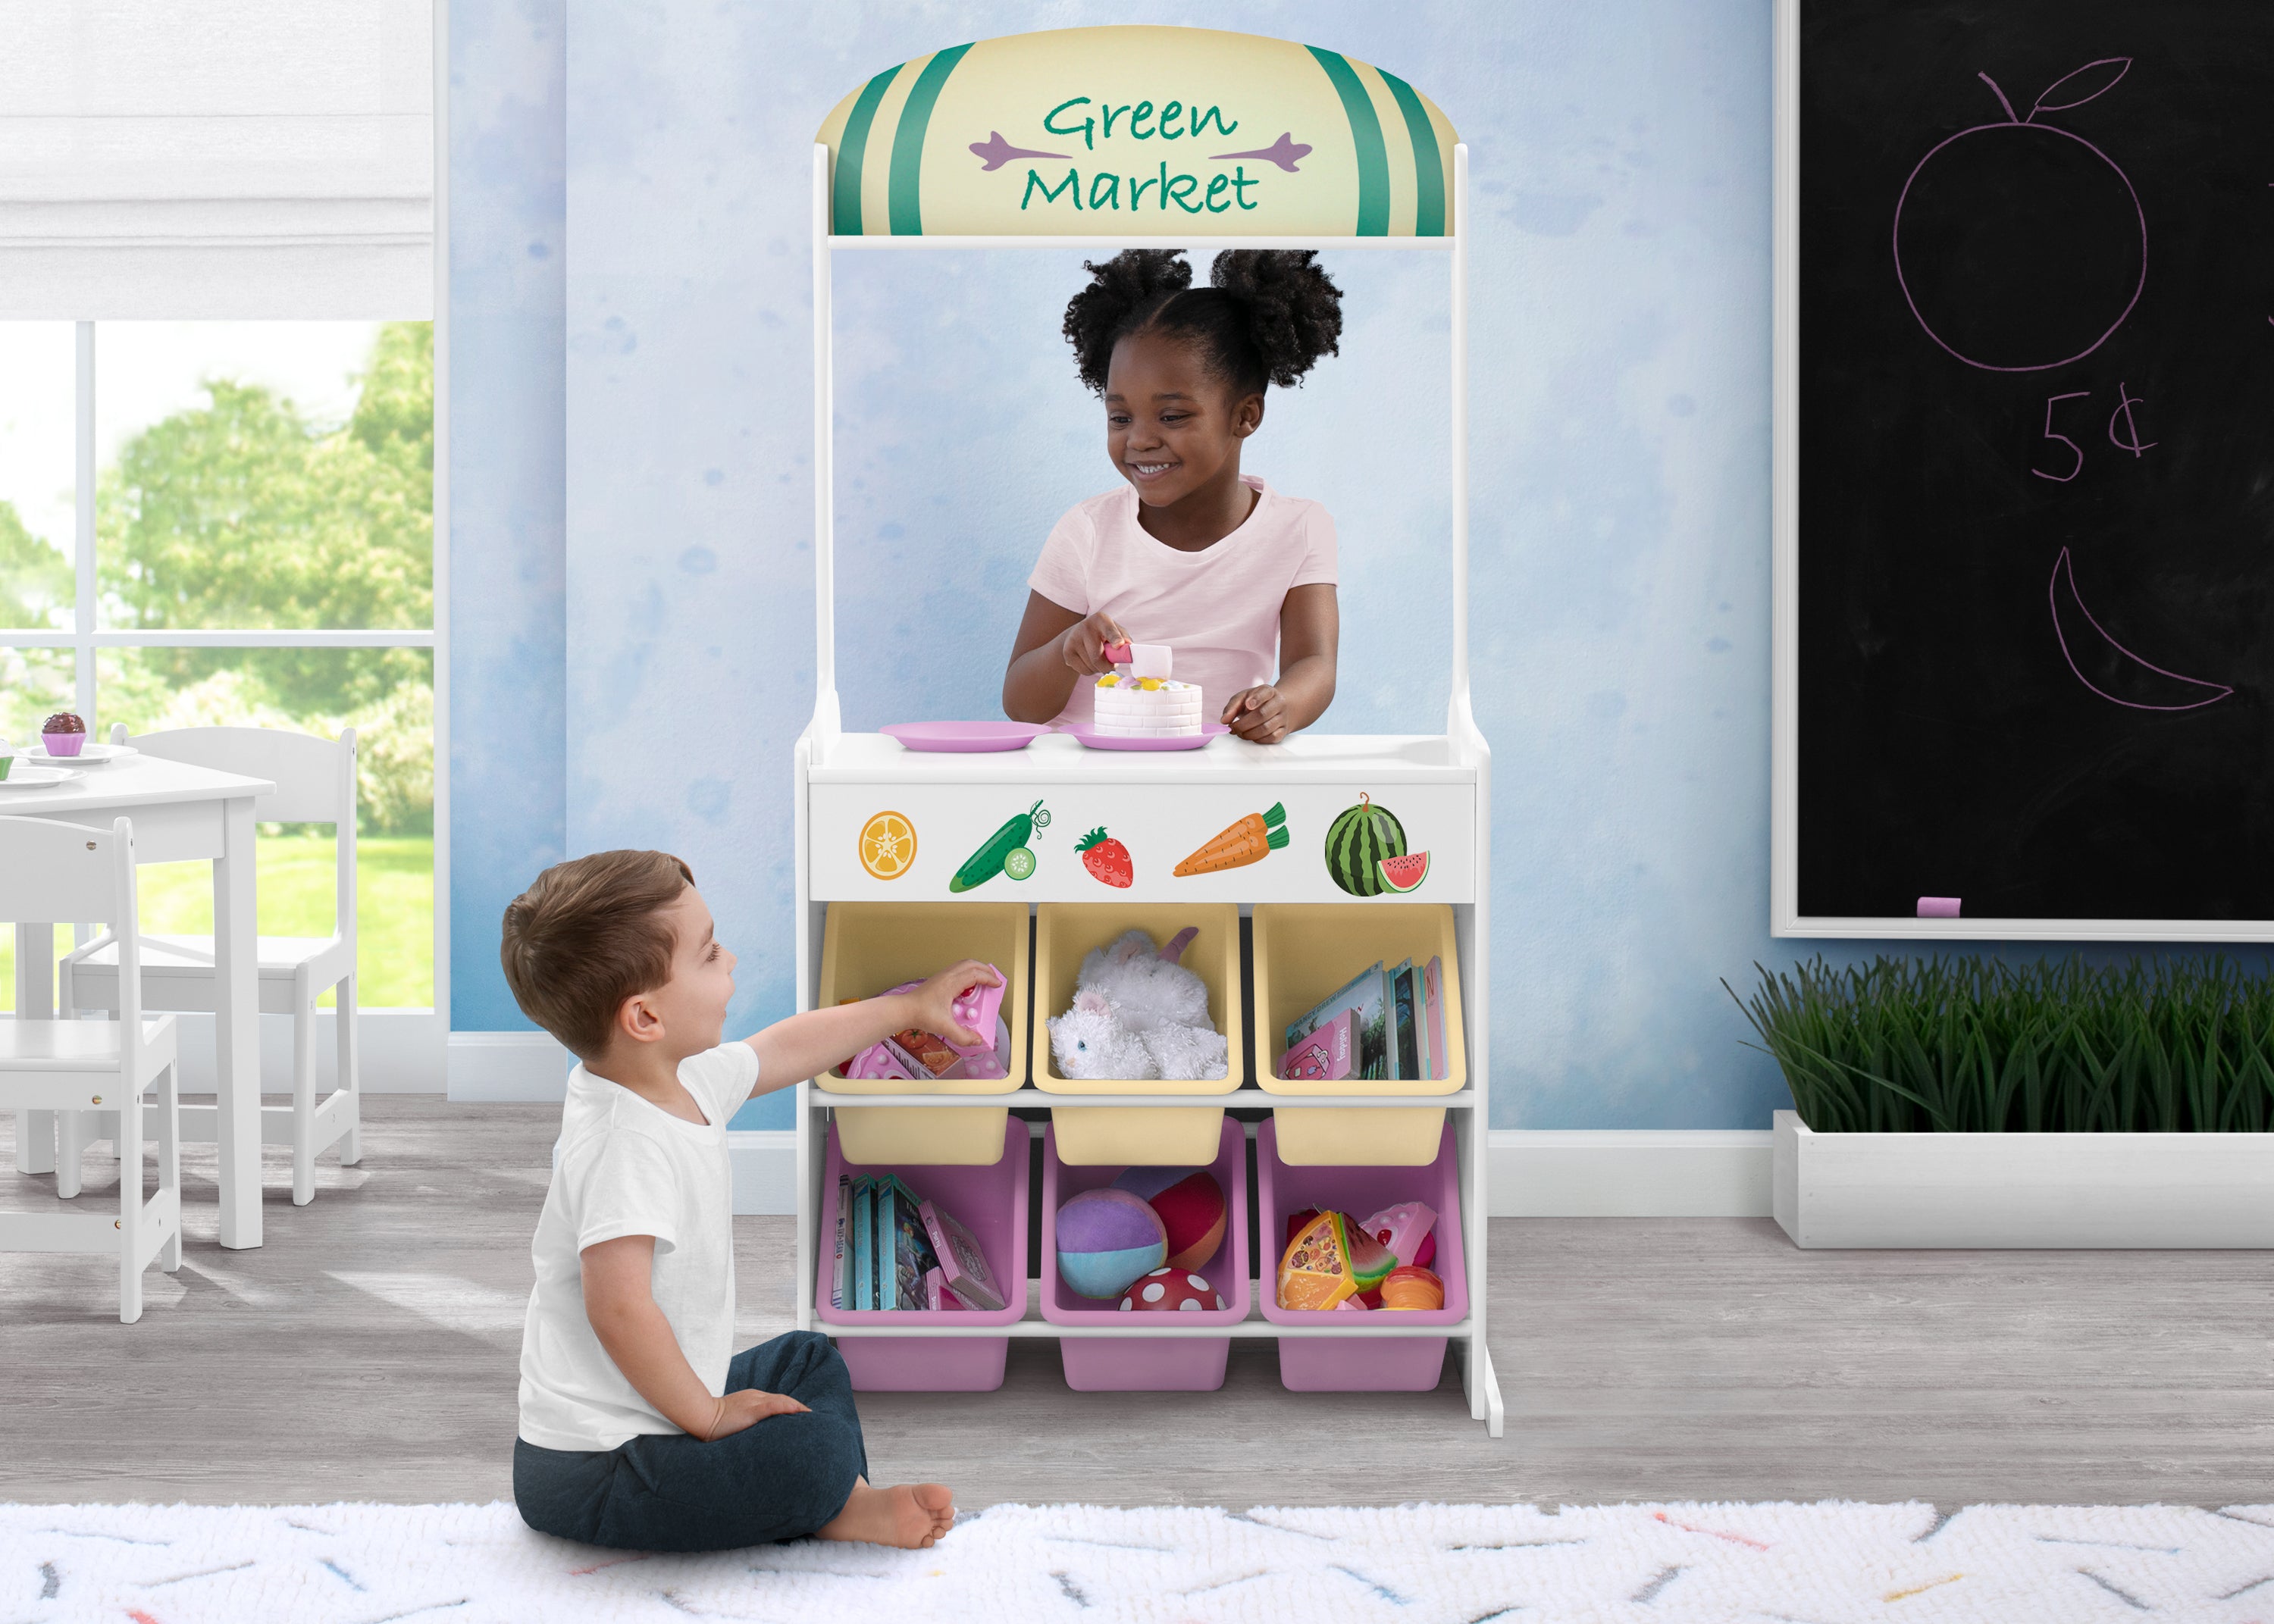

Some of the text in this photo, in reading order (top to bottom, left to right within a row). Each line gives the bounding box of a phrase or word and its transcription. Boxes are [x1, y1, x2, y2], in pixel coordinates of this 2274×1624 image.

[1043, 95, 1239, 151] Green
[1020, 161, 1260, 214] Market
[1293, 993, 1337, 1028] NANCY DREW
[1336, 1026, 1348, 1062] Holiday
